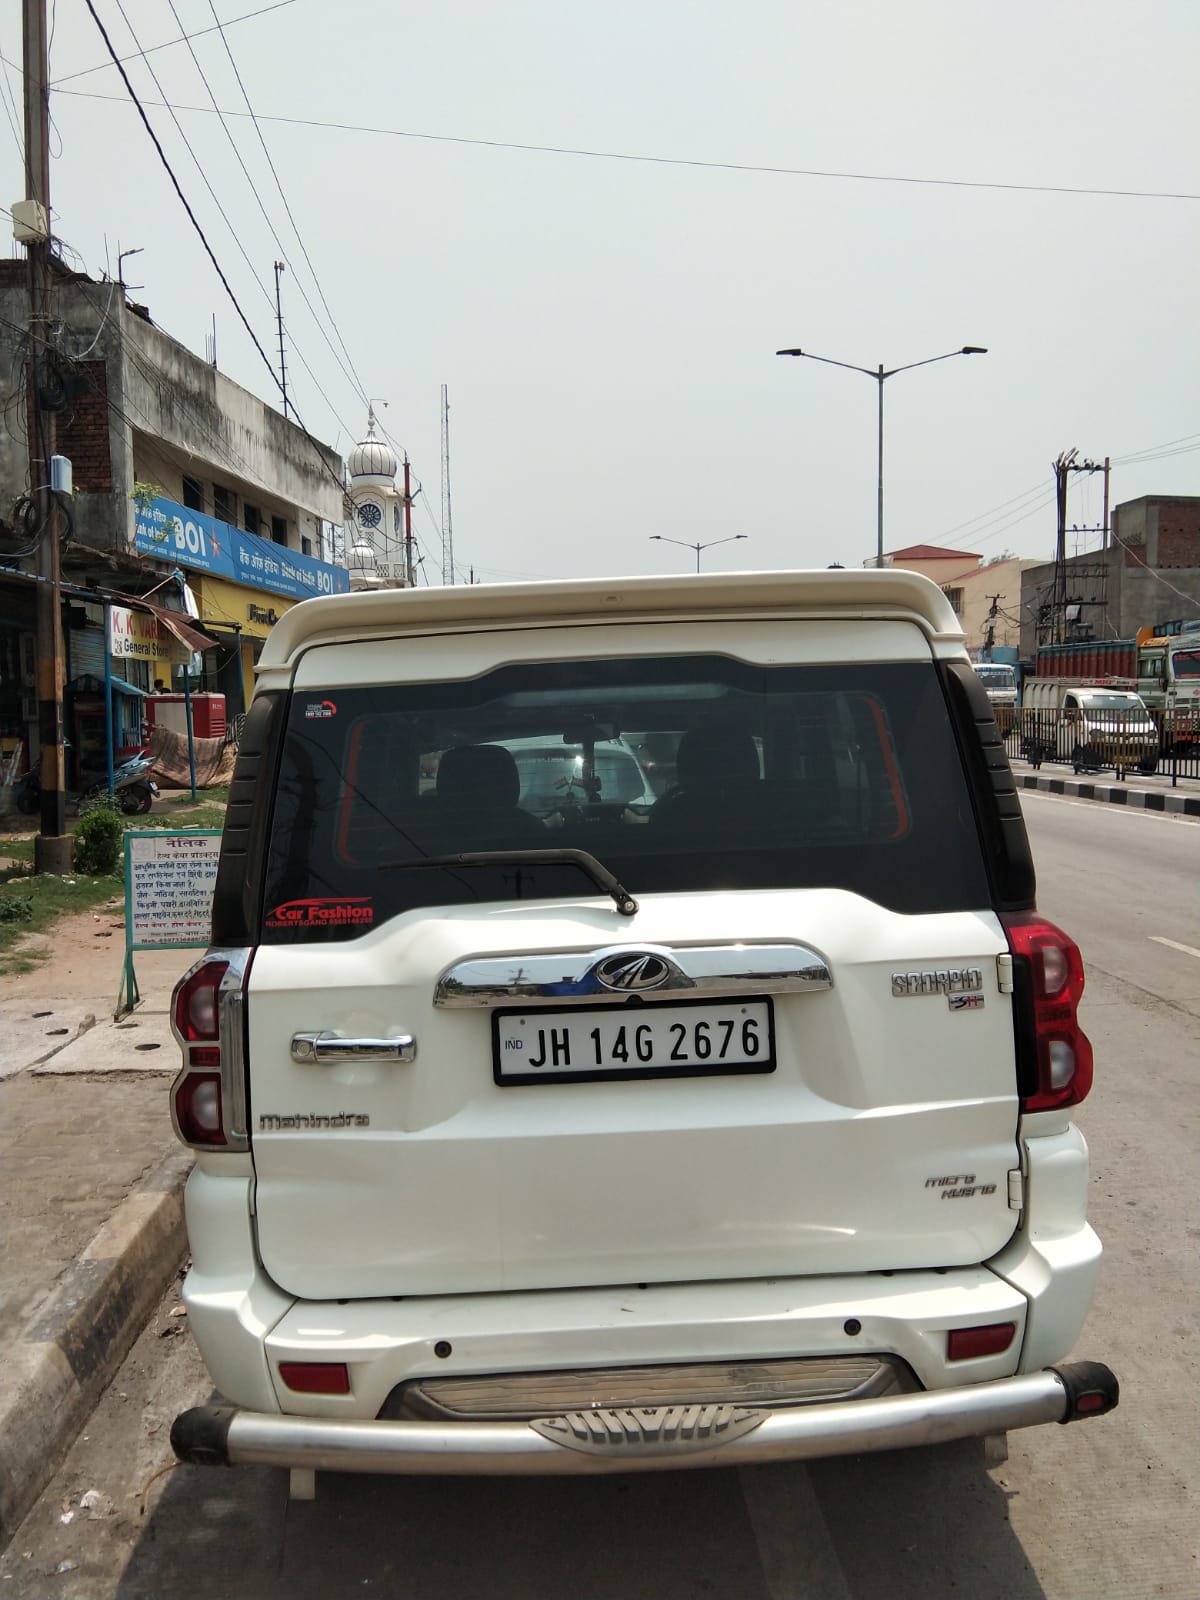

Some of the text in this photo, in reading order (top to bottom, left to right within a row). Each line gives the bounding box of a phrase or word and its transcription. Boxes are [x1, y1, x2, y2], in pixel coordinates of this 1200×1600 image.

[173, 515, 206, 557] BOI
[281, 562, 296, 580] Bank
[317, 570, 334, 594] BOI
[112, 611, 124, 634] K.
[126, 614, 137, 637] K.
[124, 638, 150, 656] General
[165, 837, 208, 848] नैतिक
[275, 905, 373, 920] Car Fashion
[892, 967, 982, 997] SCORPIO
[505, 1018, 760, 1067] IND JH 14G 2676
